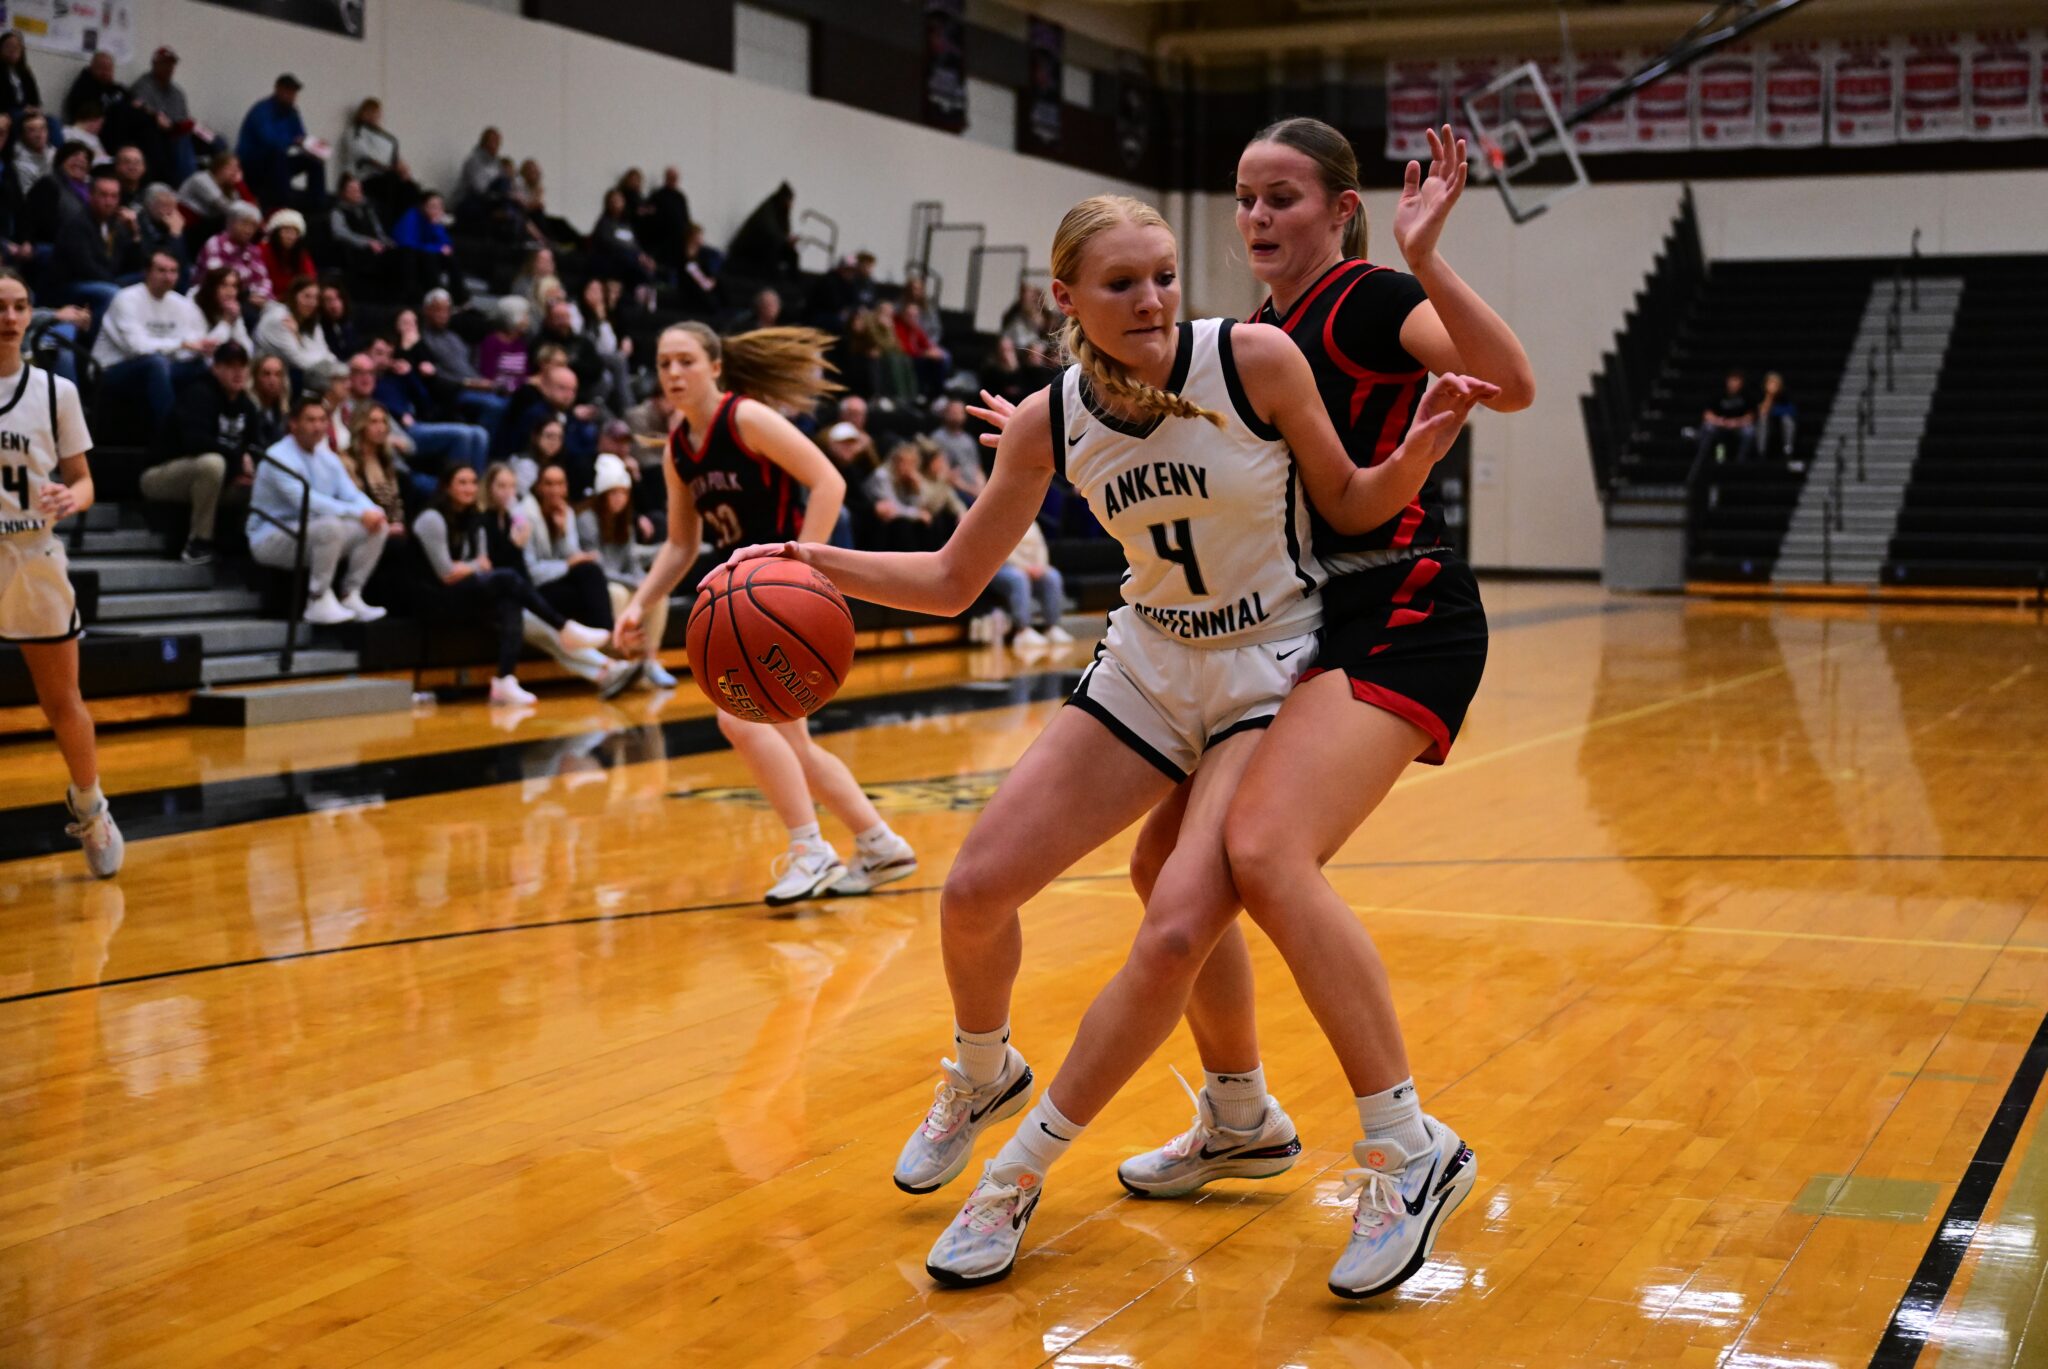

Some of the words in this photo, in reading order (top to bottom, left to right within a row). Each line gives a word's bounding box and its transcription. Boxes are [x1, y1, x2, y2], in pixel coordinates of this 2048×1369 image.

[0, 430, 30, 455] ENY
[1, 465, 29, 511] 4
[1104, 461, 1209, 520] ANKENY
[1147, 517, 1209, 596] 4
[725, 668, 770, 721] LEGA
[757, 643, 819, 709] SPALDIN
